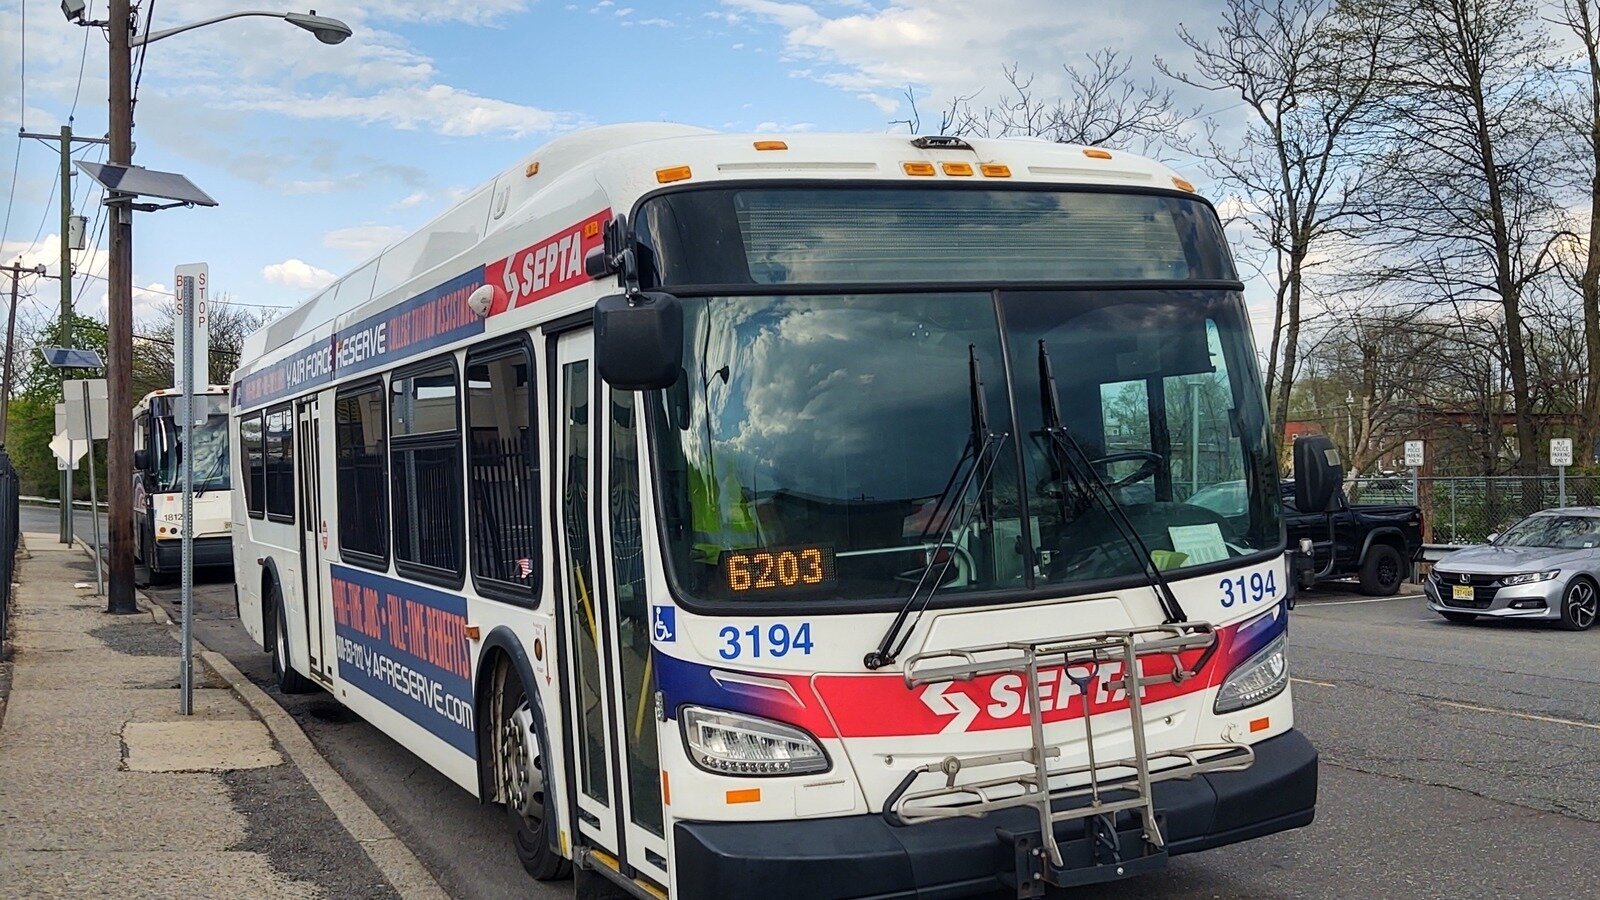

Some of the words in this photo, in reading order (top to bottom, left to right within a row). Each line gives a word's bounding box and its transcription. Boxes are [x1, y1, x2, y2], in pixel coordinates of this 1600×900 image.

[521, 231, 582, 297] SEPTA
[176, 275, 184, 315] BUS
[198, 273, 206, 329] STOP
[291, 362, 305, 387] AIR
[306, 345, 333, 380] FORCE
[335, 323, 386, 371] RESERVE
[727, 548, 823, 592] 6203
[1219, 569, 1277, 608] 3194
[425, 605, 472, 681] BENEFITS
[718, 622, 814, 660] 3194
